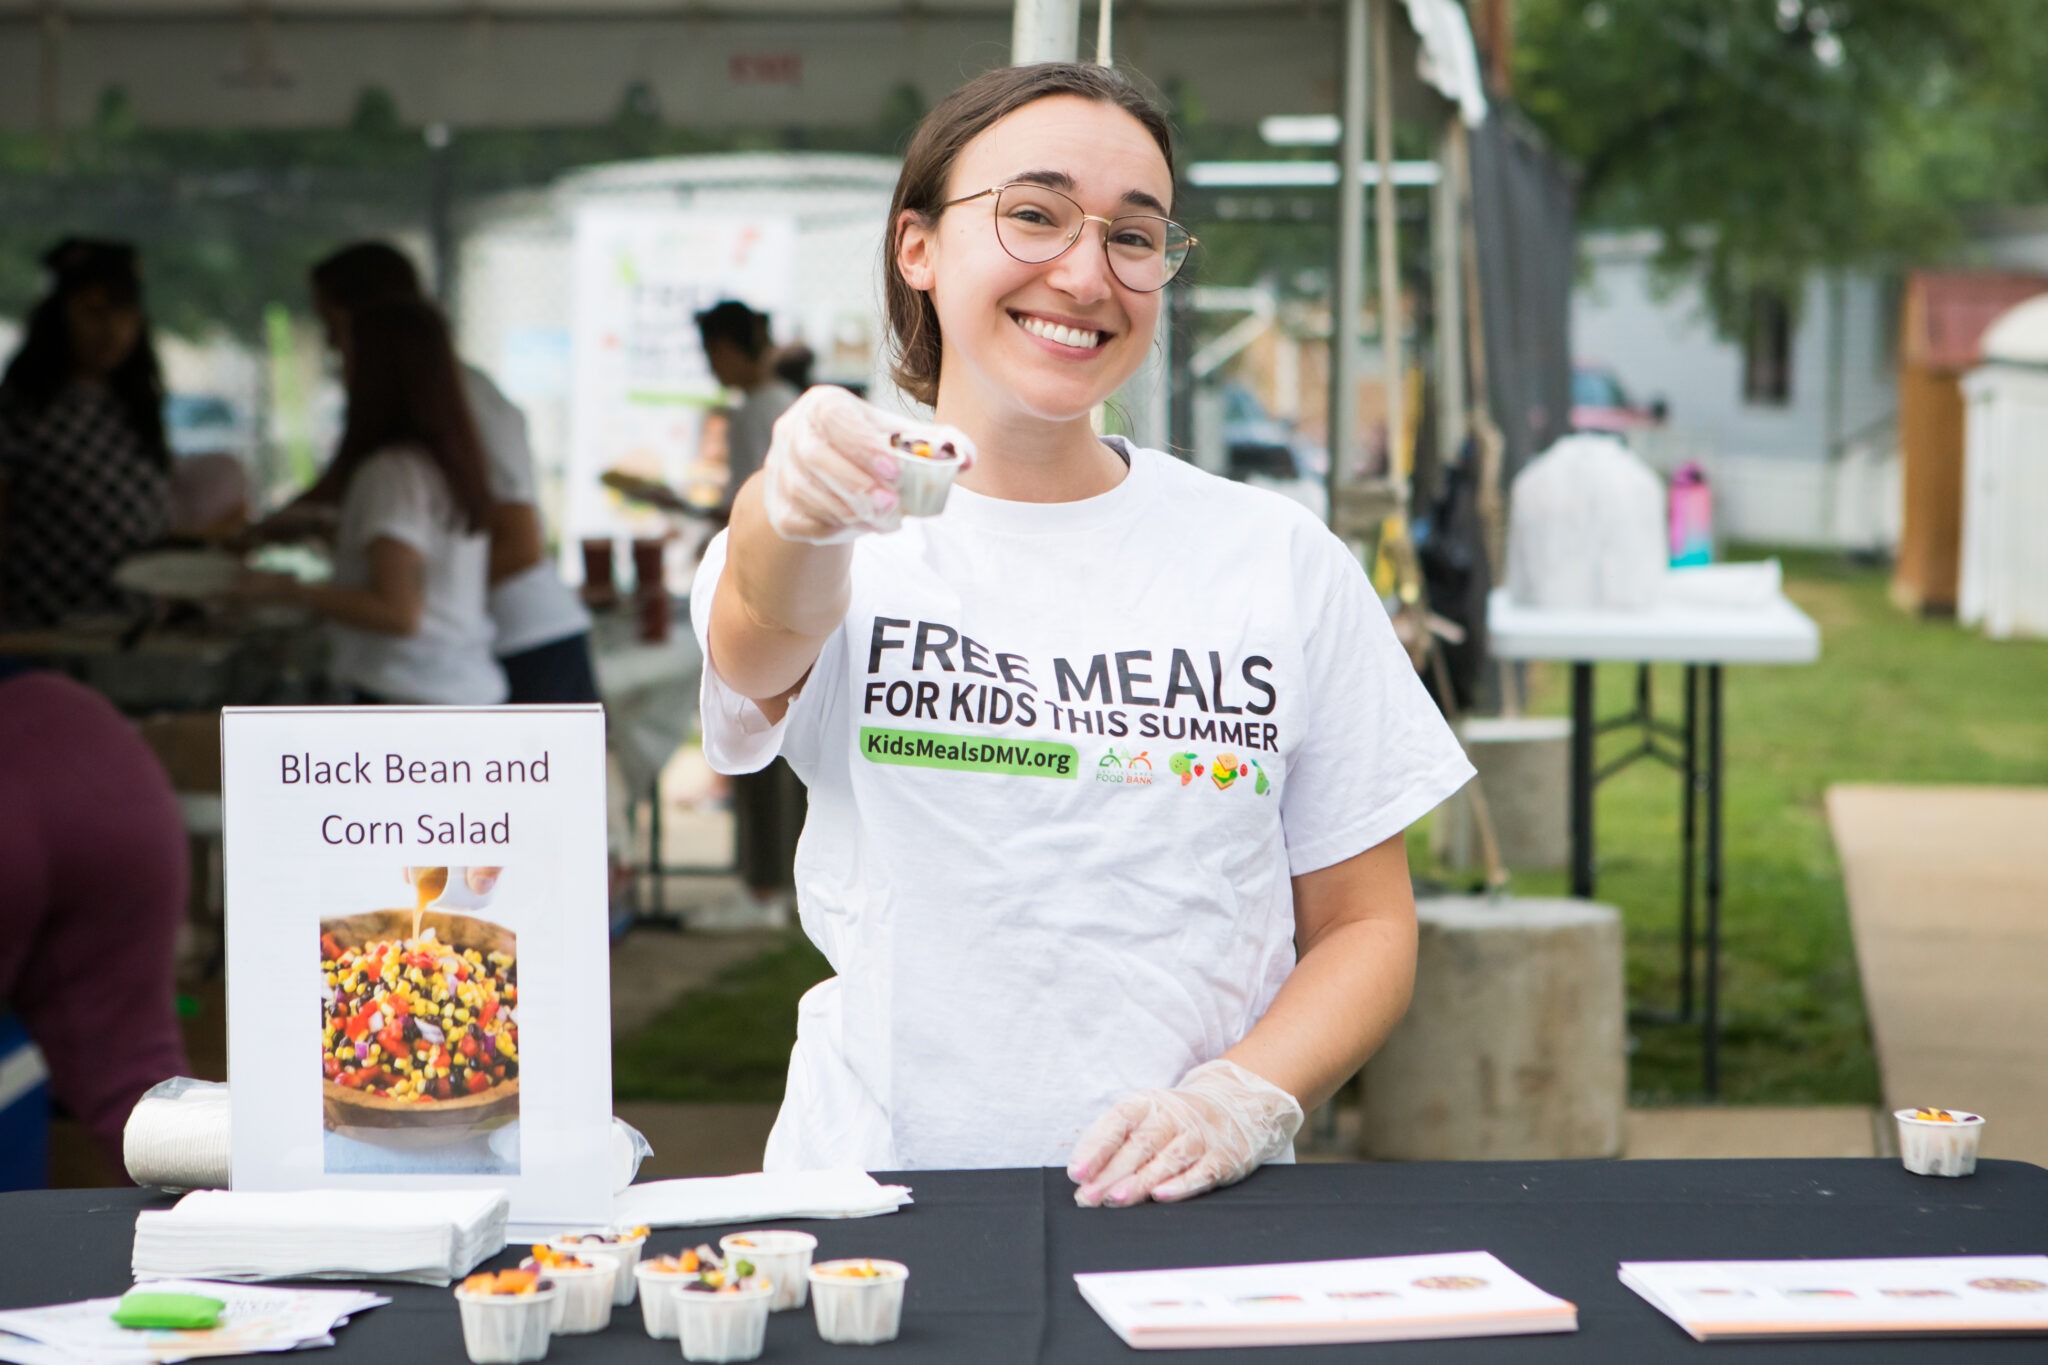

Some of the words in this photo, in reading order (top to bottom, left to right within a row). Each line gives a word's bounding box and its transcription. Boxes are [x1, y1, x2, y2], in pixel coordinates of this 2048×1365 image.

[868, 616, 1039, 693] FREE
[1053, 648, 1277, 716] MEALS
[864, 681, 940, 720] FOR
[949, 683, 1037, 727] KIDS
[1045, 701, 1129, 738] THIS
[1139, 713, 1279, 753] SUMMER
[281, 752, 372, 784] Black
[385, 754, 471, 784] Bean
[485, 751, 549, 783] and
[867, 734, 1071, 775] KidsMealsDMV.org
[1096, 773, 1124, 784] FOOD
[1126, 775, 1153, 785] BANK
[322, 815, 403, 845] Corn
[417, 812, 510, 845] Salad
